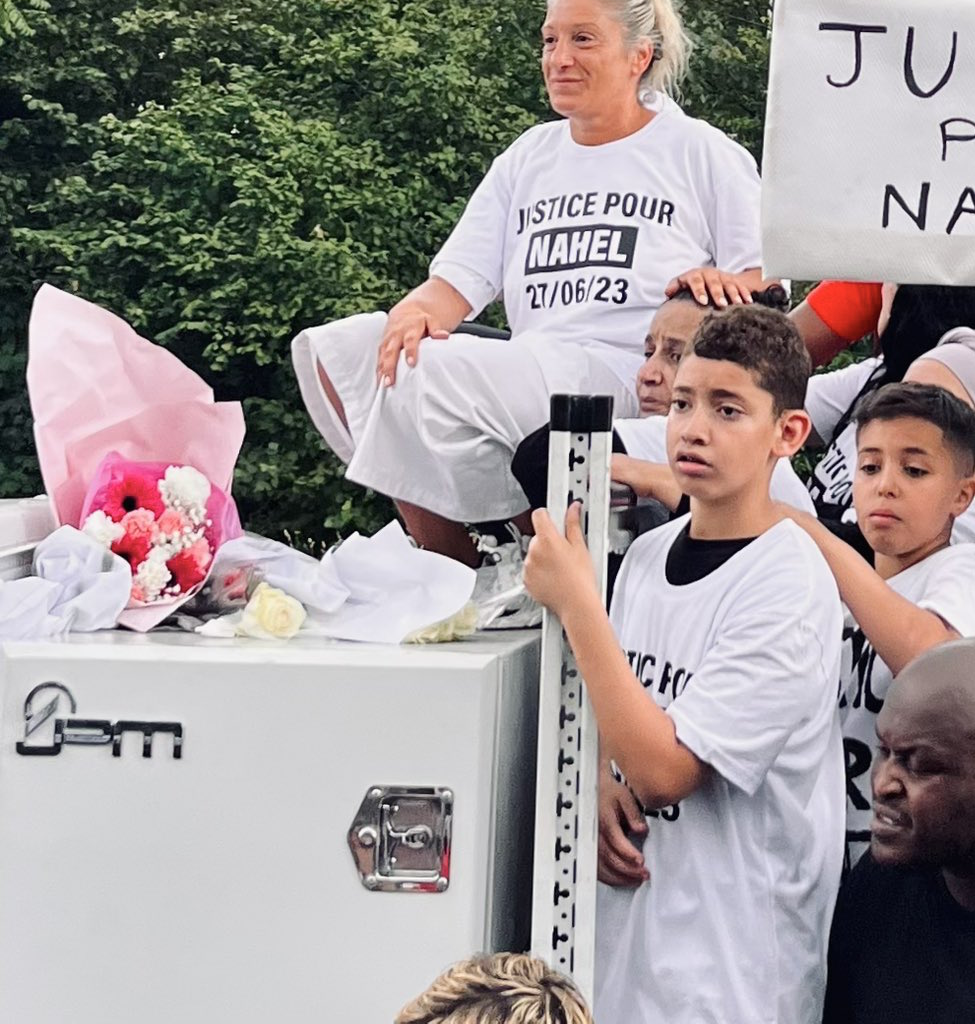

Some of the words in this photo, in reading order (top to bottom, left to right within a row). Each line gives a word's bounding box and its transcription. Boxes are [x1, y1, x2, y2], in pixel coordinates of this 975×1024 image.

[516, 190, 600, 236] JUSTICE
[602, 191, 676, 227] POUR
[527, 228, 628, 270] NAHEL
[525, 275, 631, 310] 27/06/23
